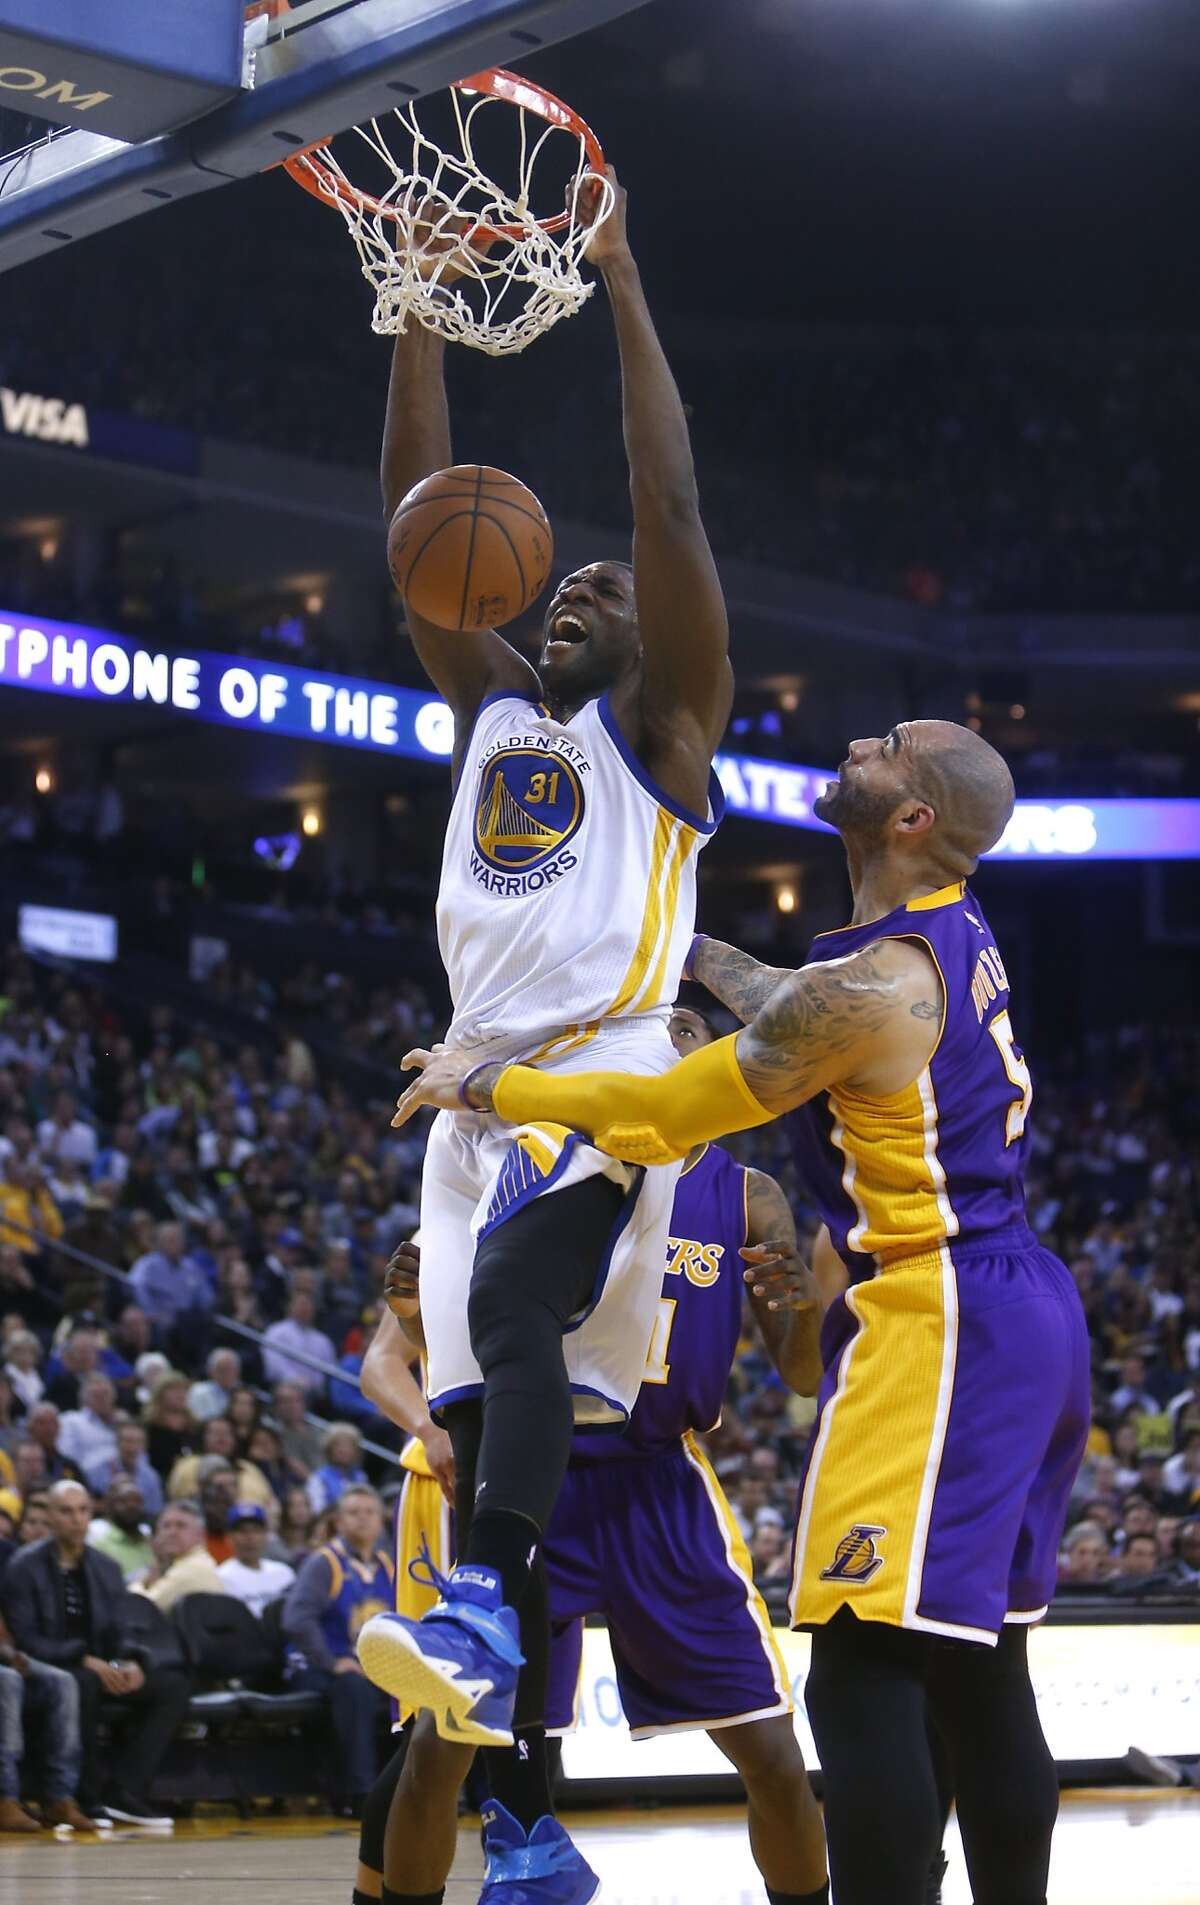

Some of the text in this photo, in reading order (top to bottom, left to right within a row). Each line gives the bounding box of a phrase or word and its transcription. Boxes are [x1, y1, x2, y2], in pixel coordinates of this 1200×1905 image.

[0, 387, 89, 447] VISA
[219, 667, 288, 724] OF
[302, 681, 399, 745] THE
[478, 736, 550, 769] GOLDEN
[524, 771, 561, 805] 31
[470, 850, 578, 896] WARRIORS
[988, 1008, 1033, 1148] 5
[665, 1236, 725, 1288] RS
